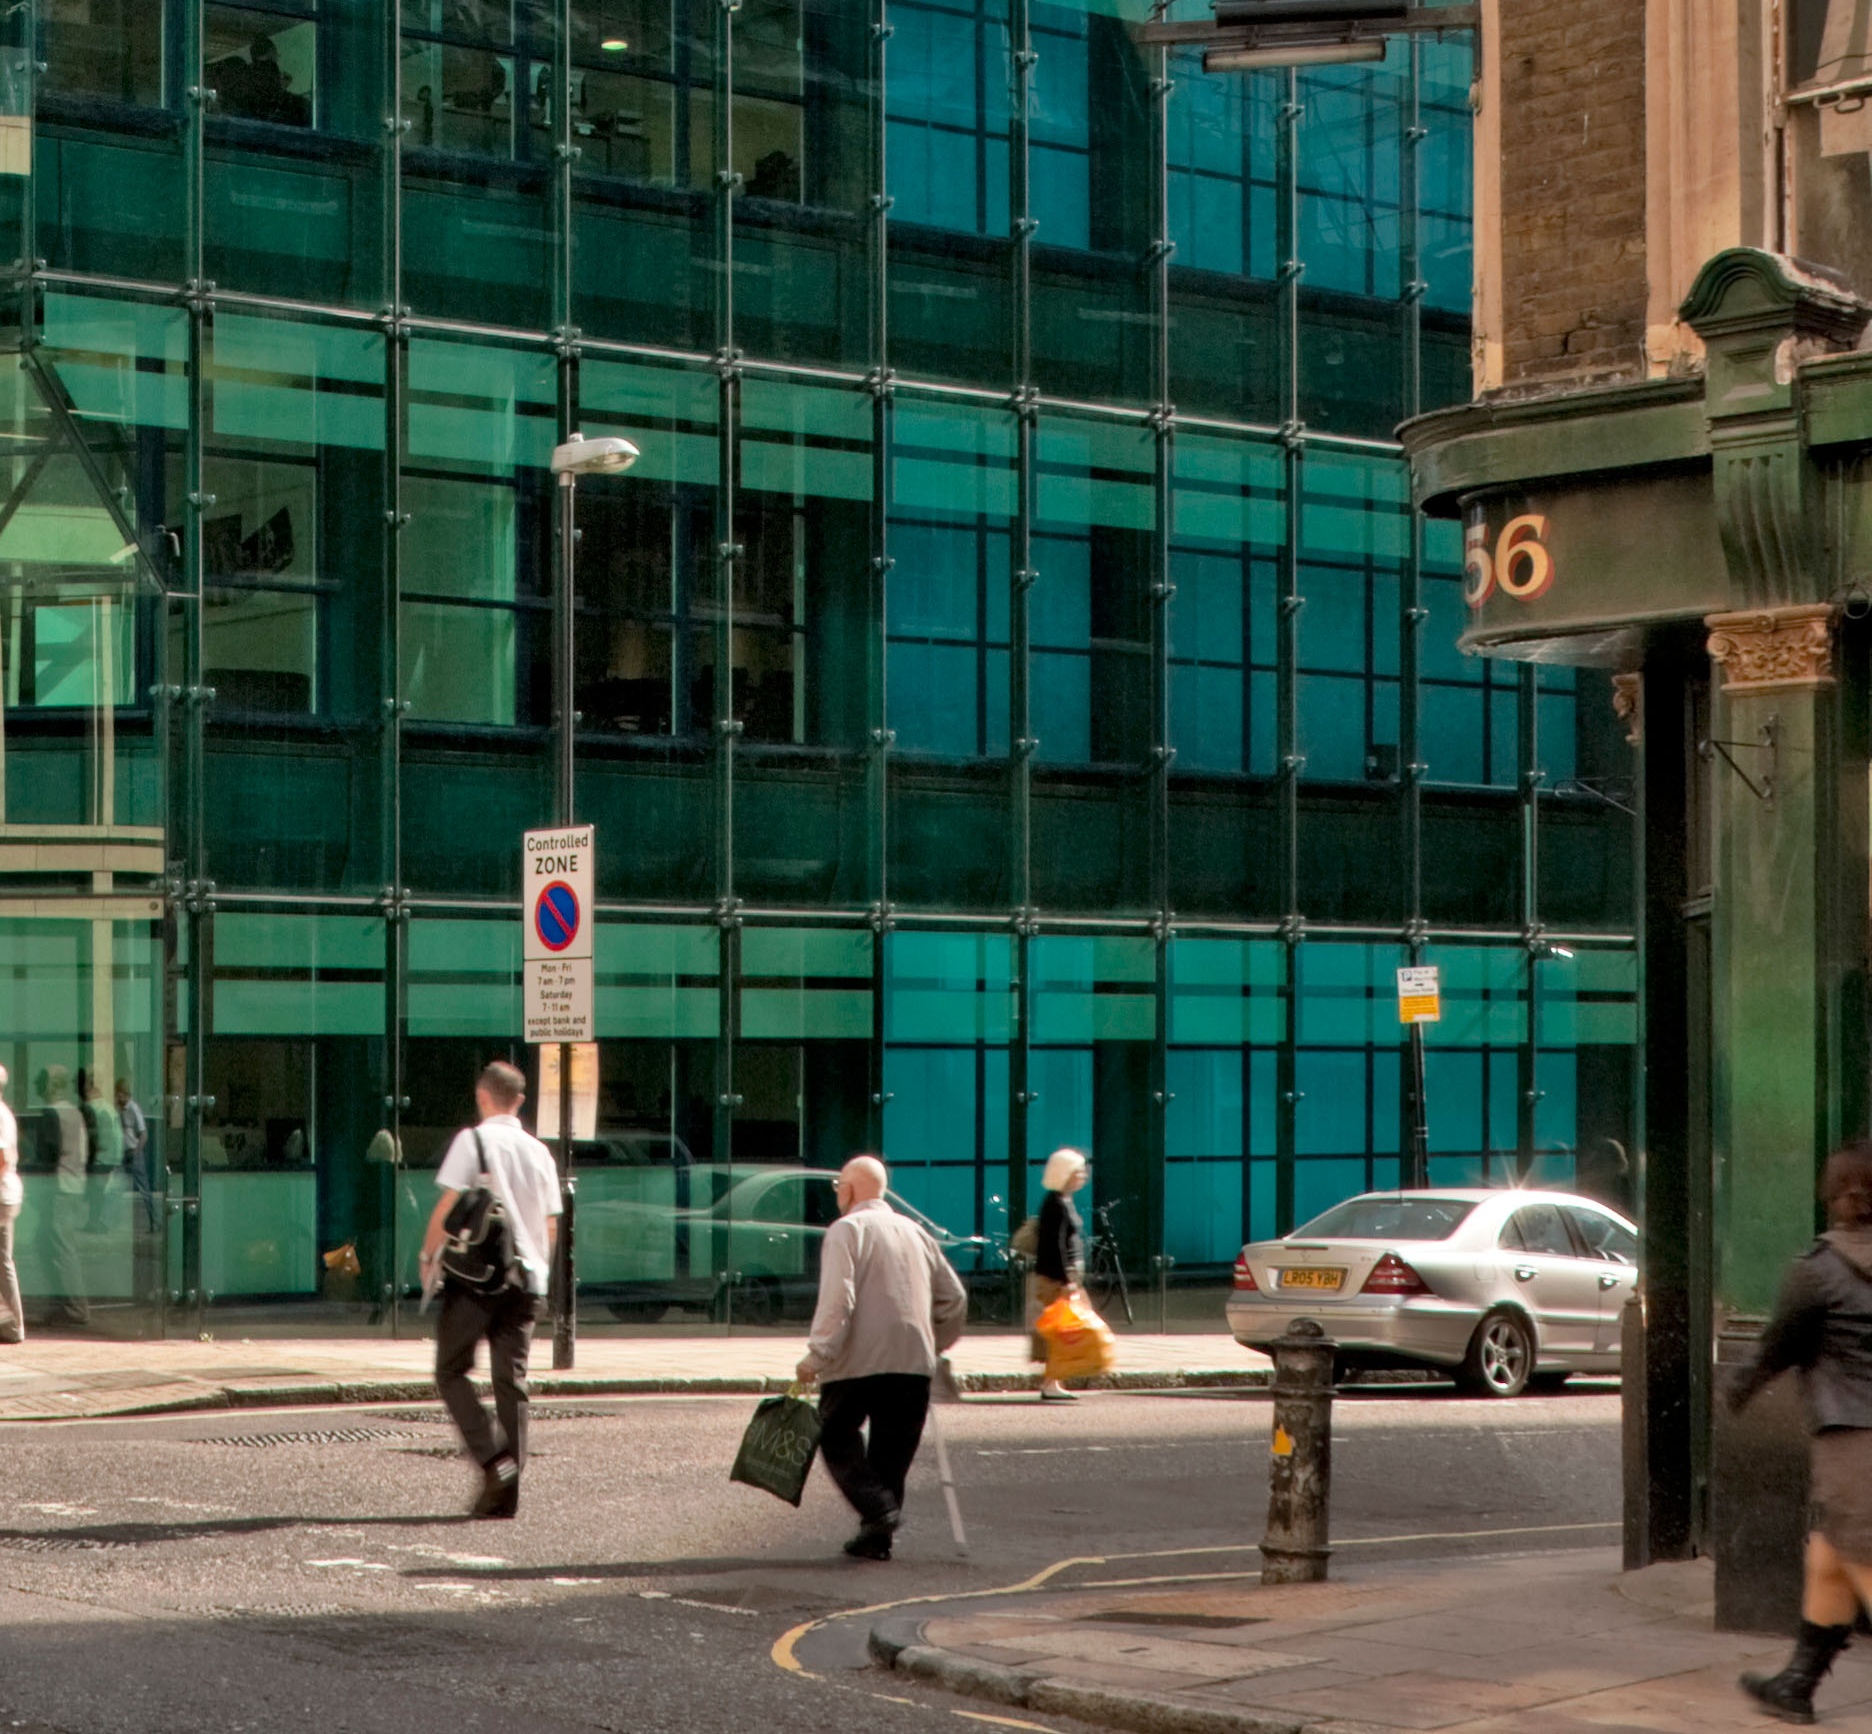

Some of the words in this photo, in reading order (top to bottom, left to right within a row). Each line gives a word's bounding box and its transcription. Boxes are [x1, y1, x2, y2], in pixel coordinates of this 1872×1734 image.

[1465, 515, 1555, 609] 56
[527, 833, 588, 852] Controlled
[535, 854, 578, 875] ZONE
[541, 963, 556, 972] Mon
[562, 962, 572, 972] Fri
[540, 990, 572, 1001] Saturday
[528, 1016, 550, 1026] except
[553, 1015, 570, 1025] bank
[573, 1015, 586, 1025] and
[530, 1028, 552, 1038] public
[554, 1027, 584, 1038] holidays
[752, 1420, 812, 1467] M&S
